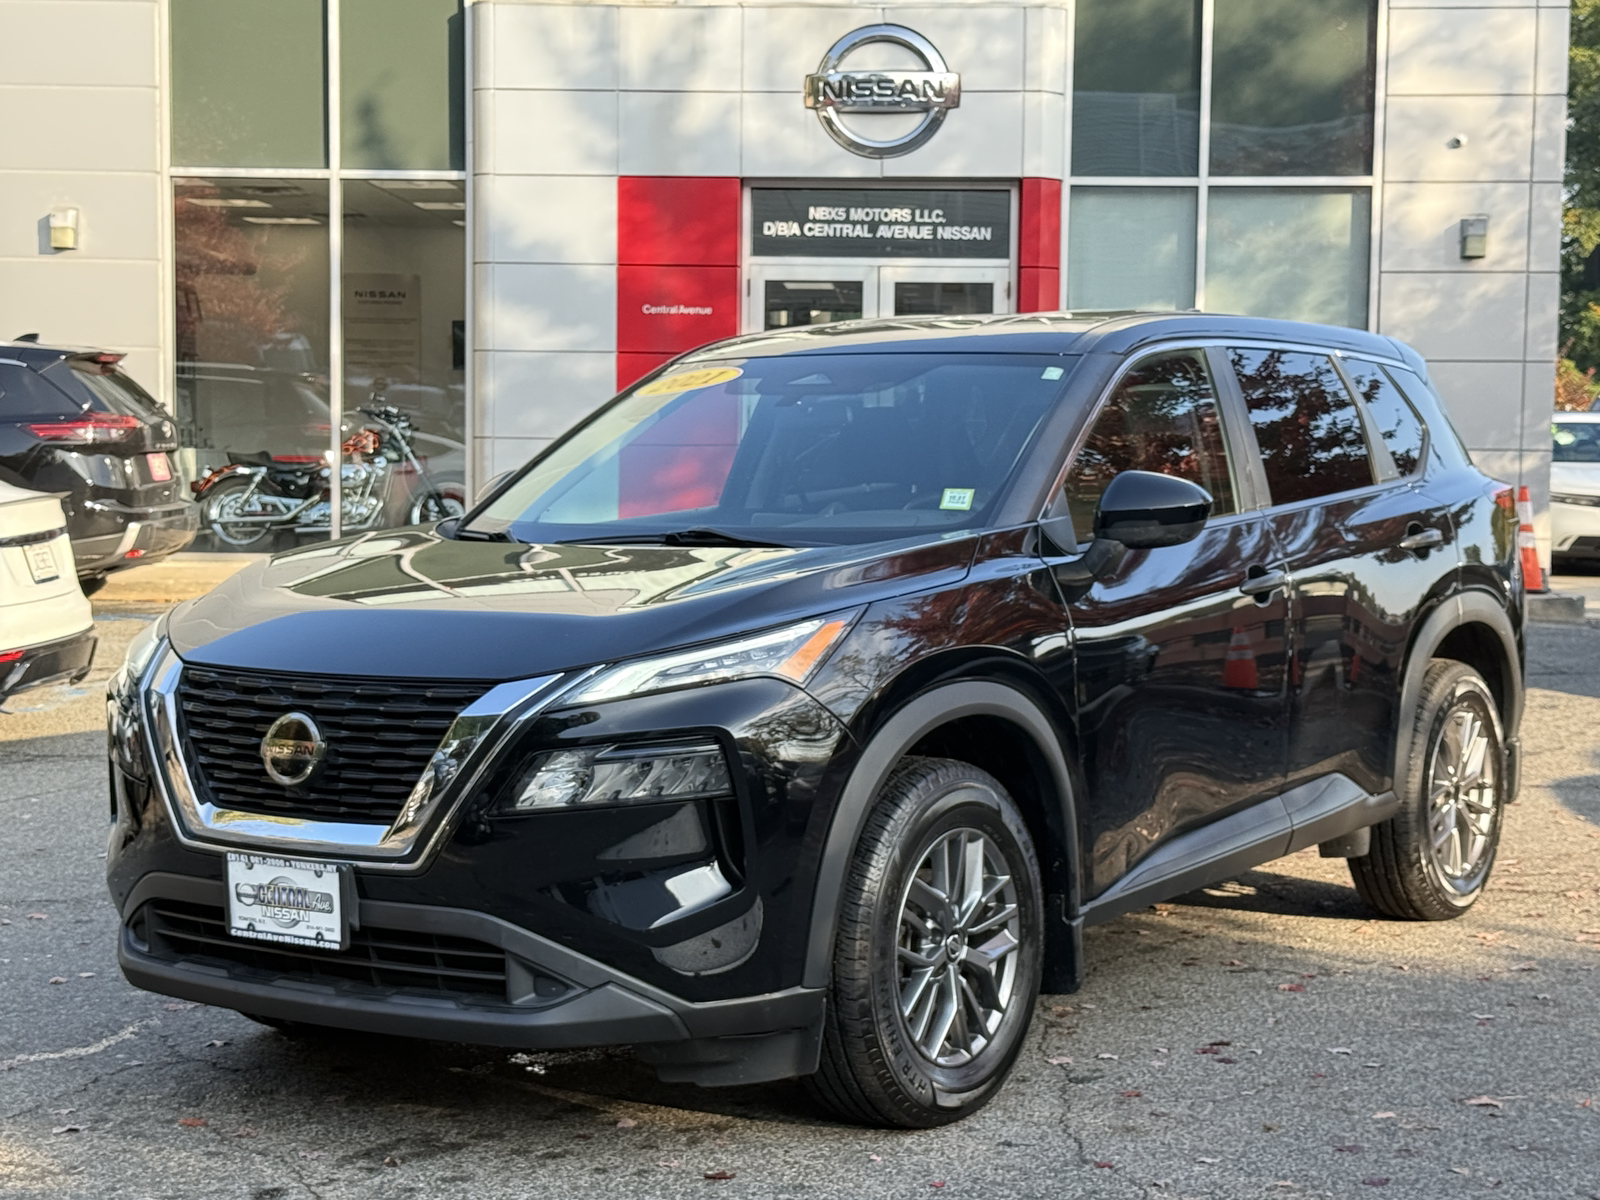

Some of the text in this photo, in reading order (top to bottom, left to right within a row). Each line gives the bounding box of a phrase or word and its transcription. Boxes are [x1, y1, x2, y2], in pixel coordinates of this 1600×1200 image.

[817, 78, 946, 104] NISSAN
[849, 208, 912, 223] MOTORS
[914, 209, 947, 224] LLC.
[763, 221, 992, 241] D/B/A CENTRAL AVENUE NISSAN
[354, 290, 407, 299] NISSAN
[641, 303, 713, 316] Central Avenue
[266, 744, 315, 756] NISSAN
[257, 884, 310, 909] CENTRAL
[261, 905, 311, 923] NISSAN
